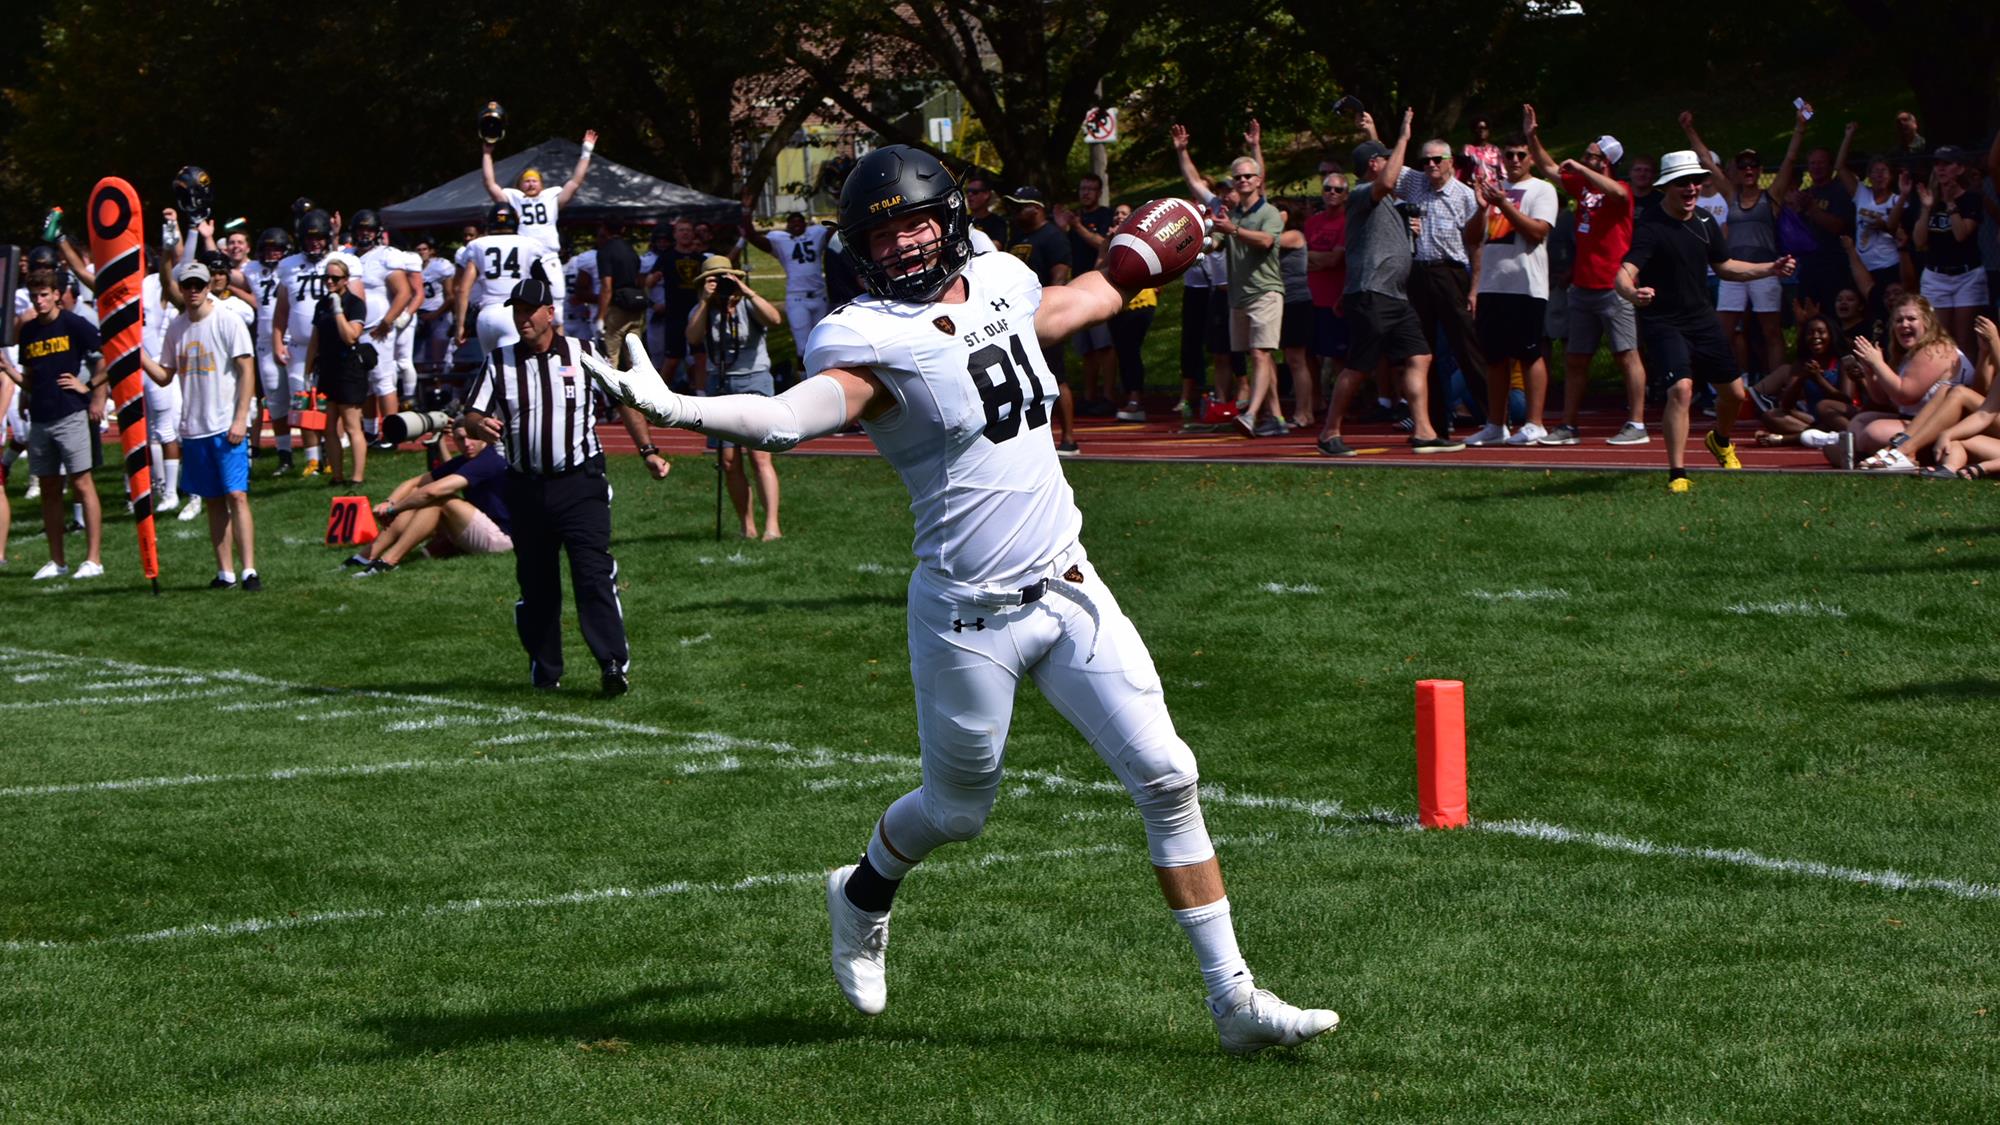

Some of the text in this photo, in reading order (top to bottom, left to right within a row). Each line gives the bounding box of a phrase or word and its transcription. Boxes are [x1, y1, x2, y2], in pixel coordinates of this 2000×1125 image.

[521, 203, 547, 225] 58
[881, 195, 901, 208] OLAF
[1154, 216, 1189, 242] Wilson
[485, 247, 520, 279] 34
[792, 240, 816, 264] 45
[296, 272, 325, 301] 70
[963, 318, 1009, 348] ST. OLAF
[565, 385, 575, 398] H
[967, 333, 1048, 445] 81
[327, 503, 357, 543] 20
